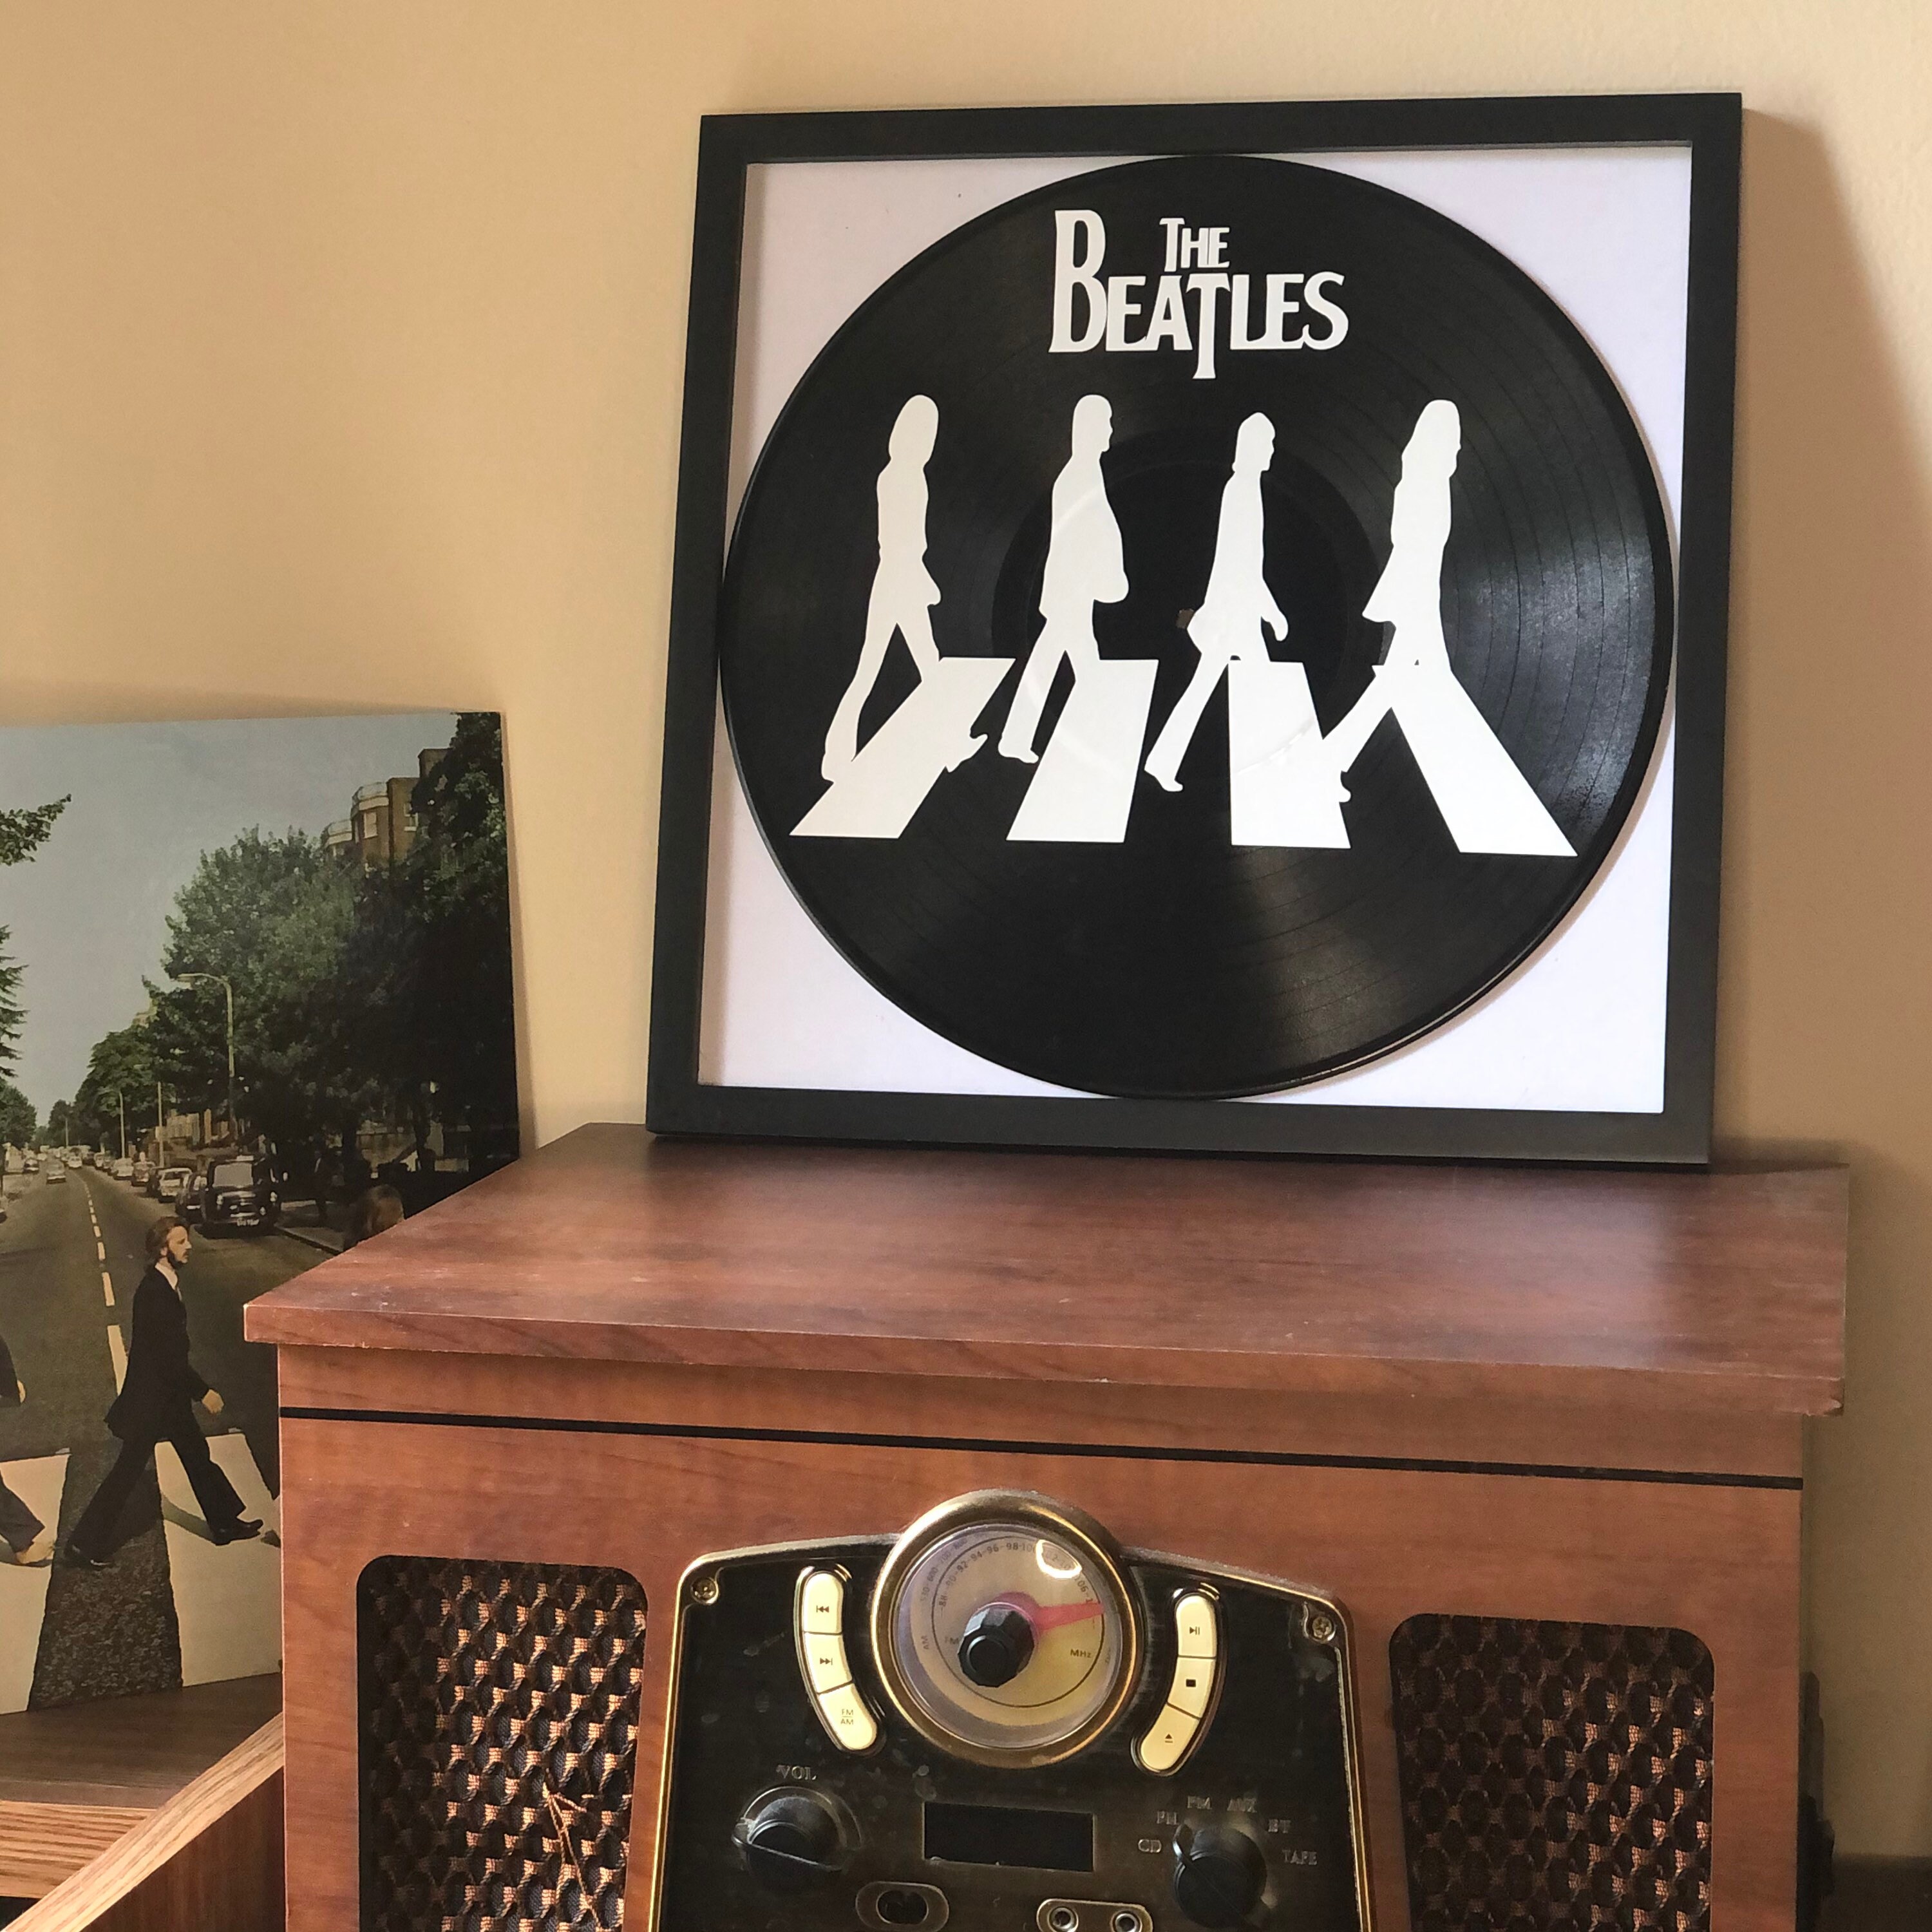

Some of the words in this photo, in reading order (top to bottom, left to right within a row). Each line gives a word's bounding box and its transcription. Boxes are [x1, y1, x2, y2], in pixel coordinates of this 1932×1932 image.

[1159, 217, 1230, 272] THE
[1048, 209, 1349, 379] BEATLES
[957, 1560, 969, 1573] 92
[971, 1551, 983, 1562] 94
[987, 1544, 999, 1554] 96
[1006, 1542, 1019, 1551] 98
[1070, 1649, 1092, 1659] MHz
[1138, 1839, 1162, 1853] CD
[1282, 1849, 1318, 1865] TAPE
